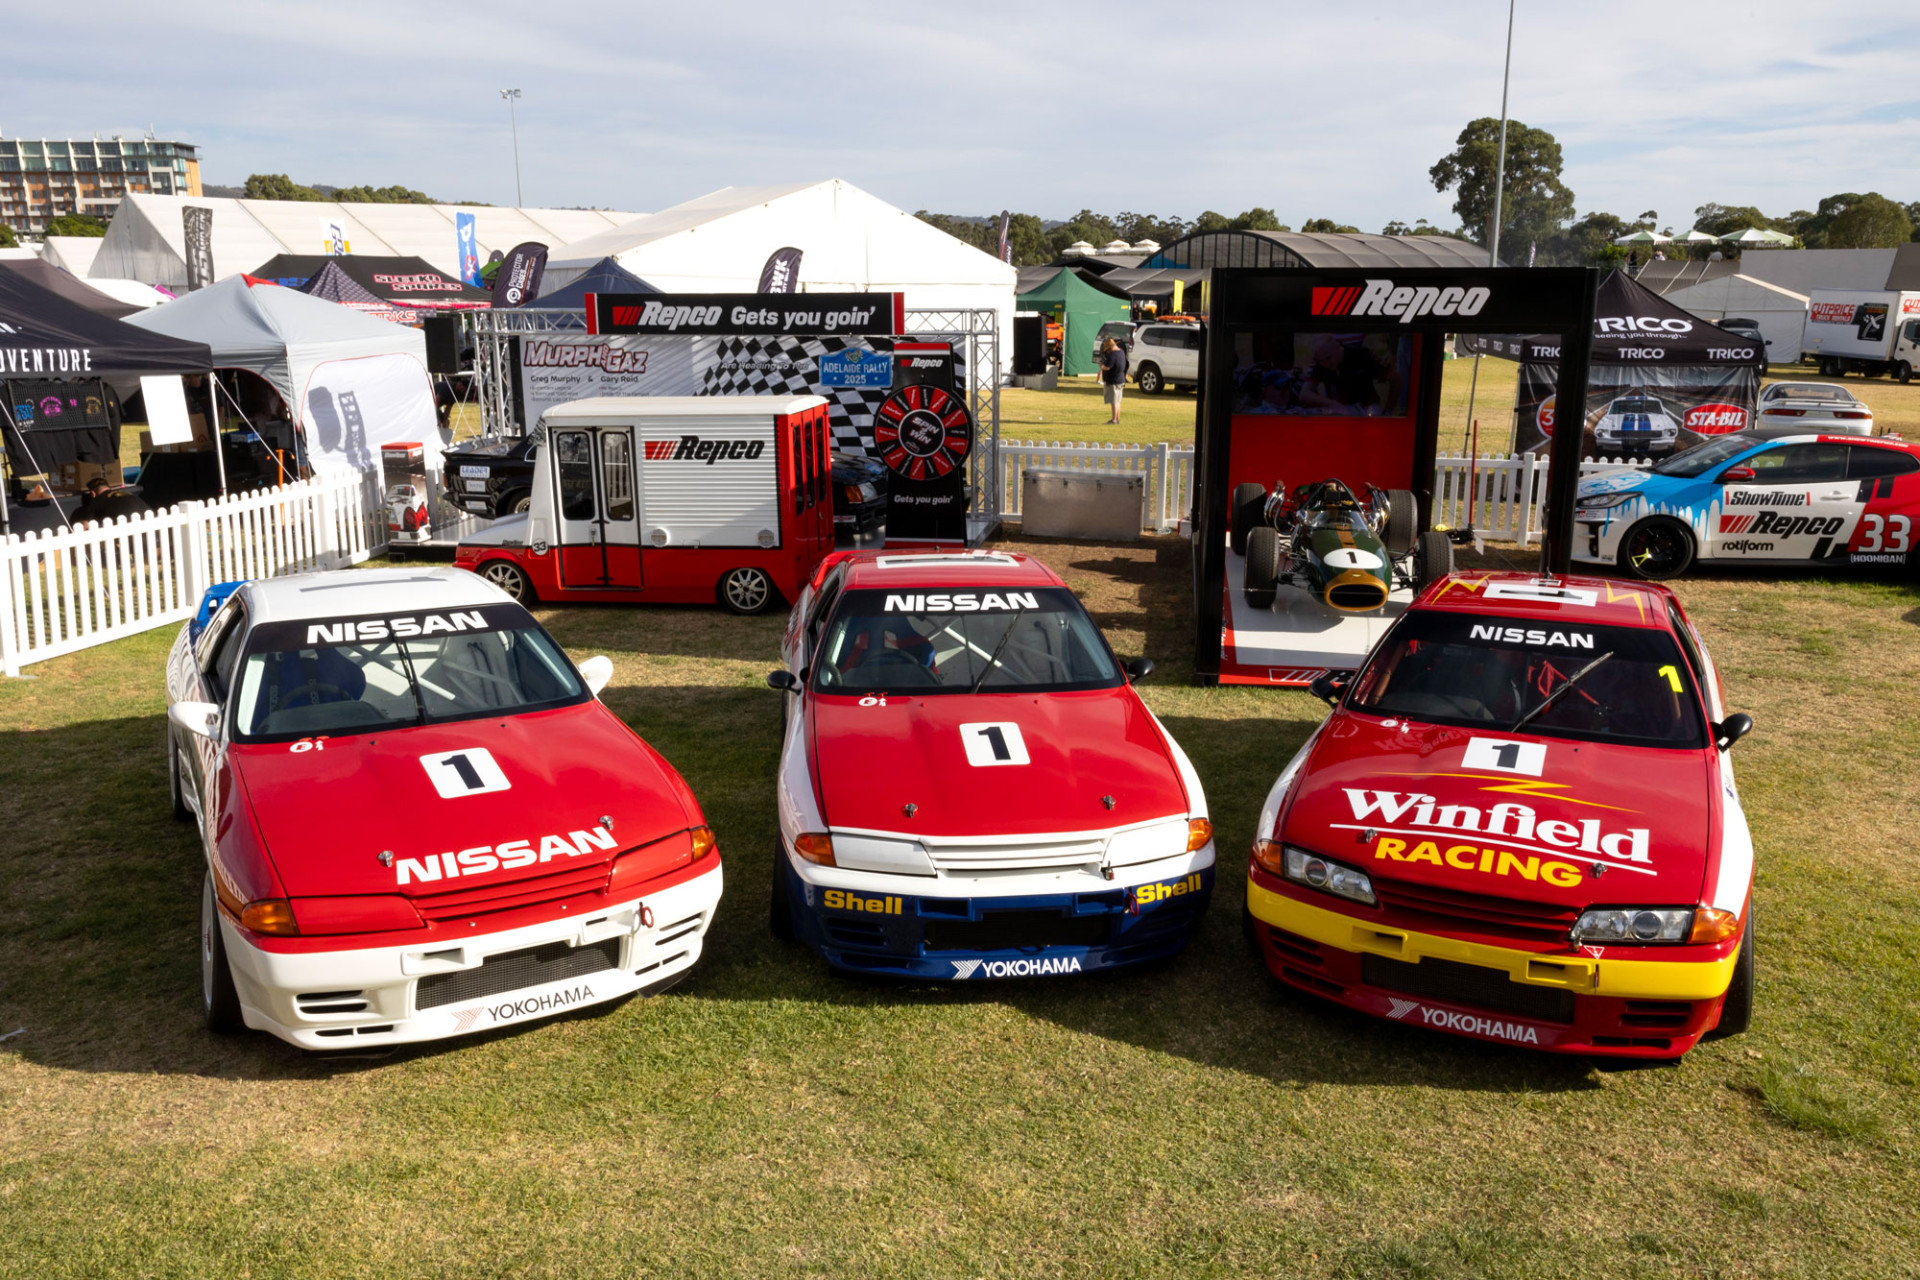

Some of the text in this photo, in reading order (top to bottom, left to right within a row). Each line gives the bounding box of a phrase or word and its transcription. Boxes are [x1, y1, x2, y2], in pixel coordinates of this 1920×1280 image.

[509, 253, 523, 287] PROTECTOR
[1350, 279, 1491, 323] Repco
[1811, 303, 1856, 314] CUTPRICE
[638, 301, 876, 331] Repco Gets you goin'
[1594, 316, 1693, 333] RICO
[1627, 332, 1644, 340] you
[524, 341, 602, 367] MURPH
[605, 348, 648, 373] GAZ
[911, 357, 943, 369] Repco
[1618, 347, 1665, 360] TRICO
[1707, 348, 1754, 360] TRICO
[721, 361, 737, 370] Are
[738, 361, 777, 371] Heading
[823, 362, 888, 374] ADELAIDE RALLY
[530, 375, 639, 383] Greg Murphy & Gary Reid
[844, 375, 867, 385] 2025
[912, 416, 940, 435] SPIN
[1687, 412, 1744, 427] STA-BIL
[909, 429, 932, 445] WIN
[673, 436, 765, 465] Repco
[894, 495, 914, 503] Gets
[916, 497, 932, 505] you
[1730, 491, 1805, 507] ShowTime
[1748, 511, 1845, 539] Repco
[1857, 513, 1911, 553] 33
[533, 541, 547, 552] 33
[1345, 551, 1358, 564] 1
[1722, 540, 1774, 554] rotiform
[884, 592, 1039, 612] NISSAN
[306, 611, 489, 644] NISSAN
[1470, 624, 1594, 649] NISSAN
[1658, 665, 1683, 693] 1
[977, 726, 1011, 760] 1
[1492, 743, 1520, 769] 1
[441, 754, 485, 789] 1
[1342, 787, 1653, 864] Winfield
[396, 826, 618, 885] NISSAN
[1375, 837, 1583, 888] RACING
[1136, 873, 1202, 905] Shell
[824, 890, 902, 915] Shell
[982, 957, 1081, 979] YOKOHAMA
[488, 985, 595, 1022] YOKOHAMA
[1420, 1006, 1538, 1044] YOKOHAMA
